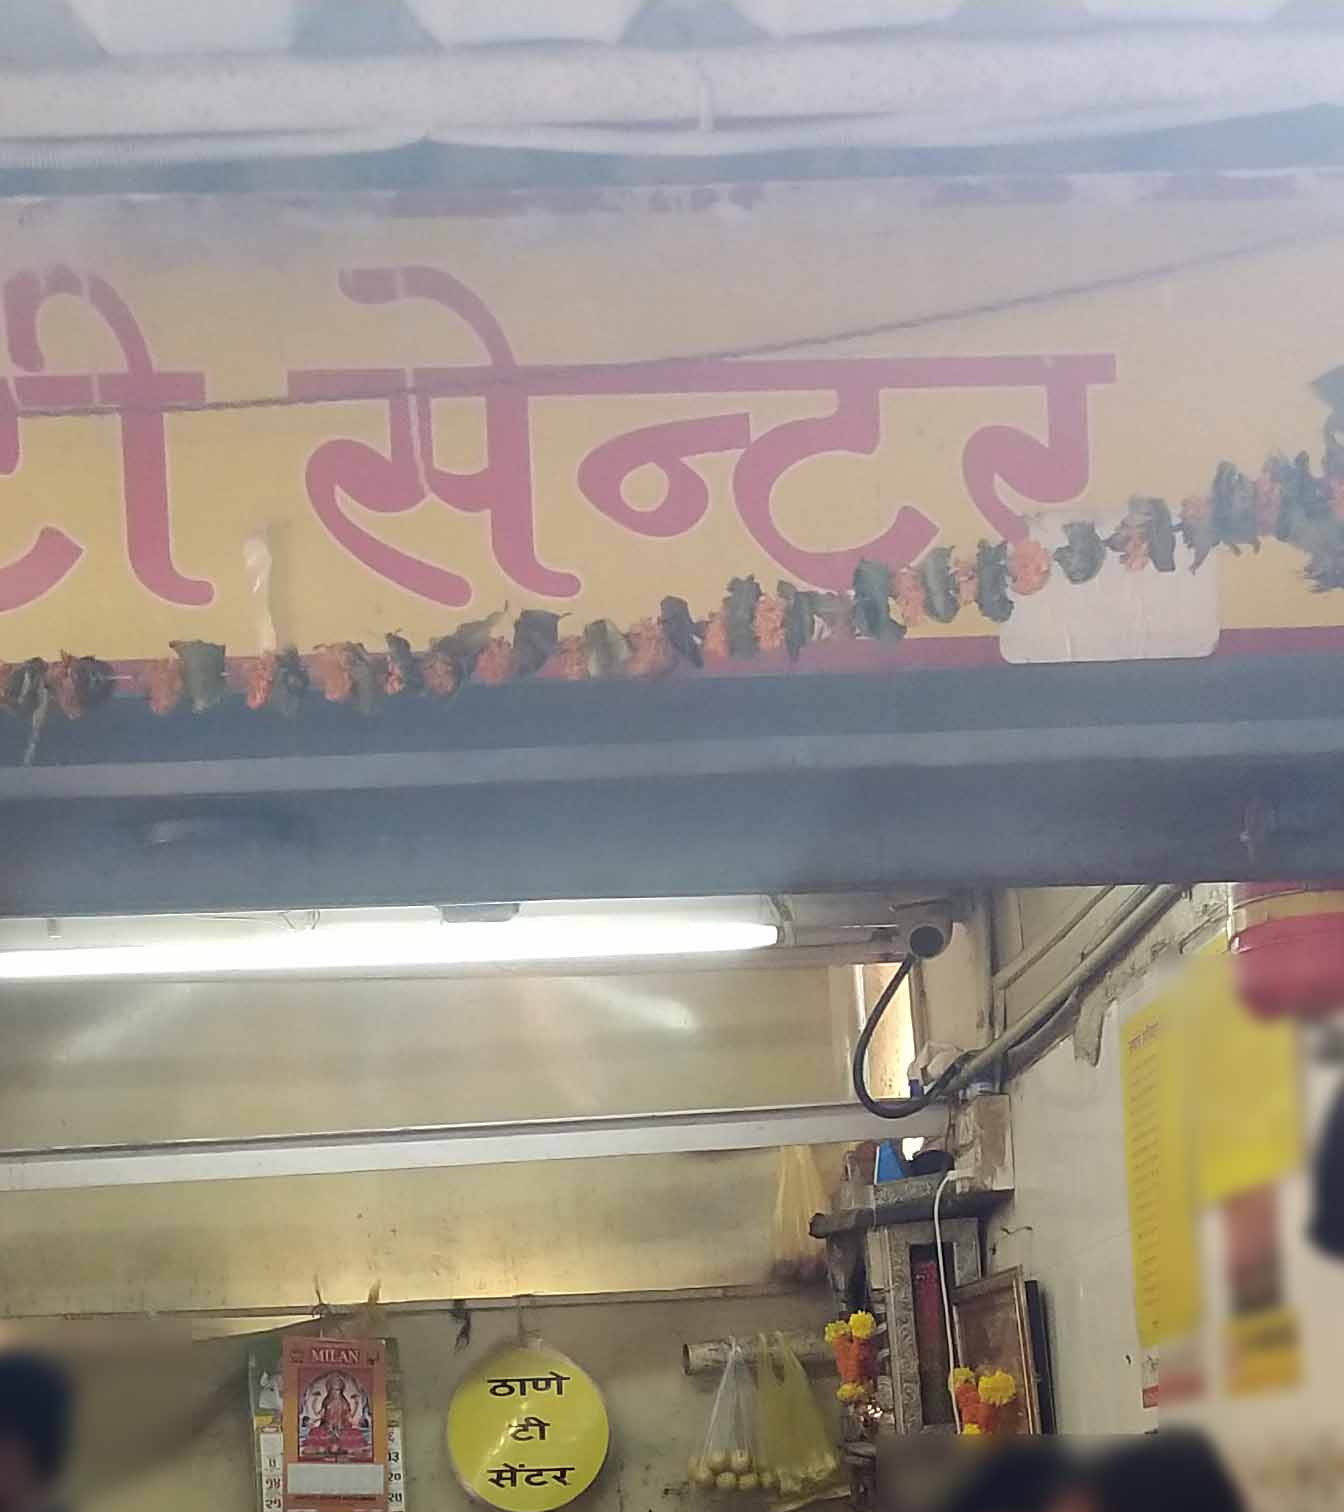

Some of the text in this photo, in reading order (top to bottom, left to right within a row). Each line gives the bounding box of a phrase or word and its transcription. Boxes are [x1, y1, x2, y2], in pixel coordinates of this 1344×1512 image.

[288, 267, 1117, 608] सेन्टर
[311, 1349, 360, 1362] MILAN
[487, 1371, 571, 1397] ठाणे
[508, 1416, 551, 1441] टी
[487, 1462, 576, 1488] सेंटर
